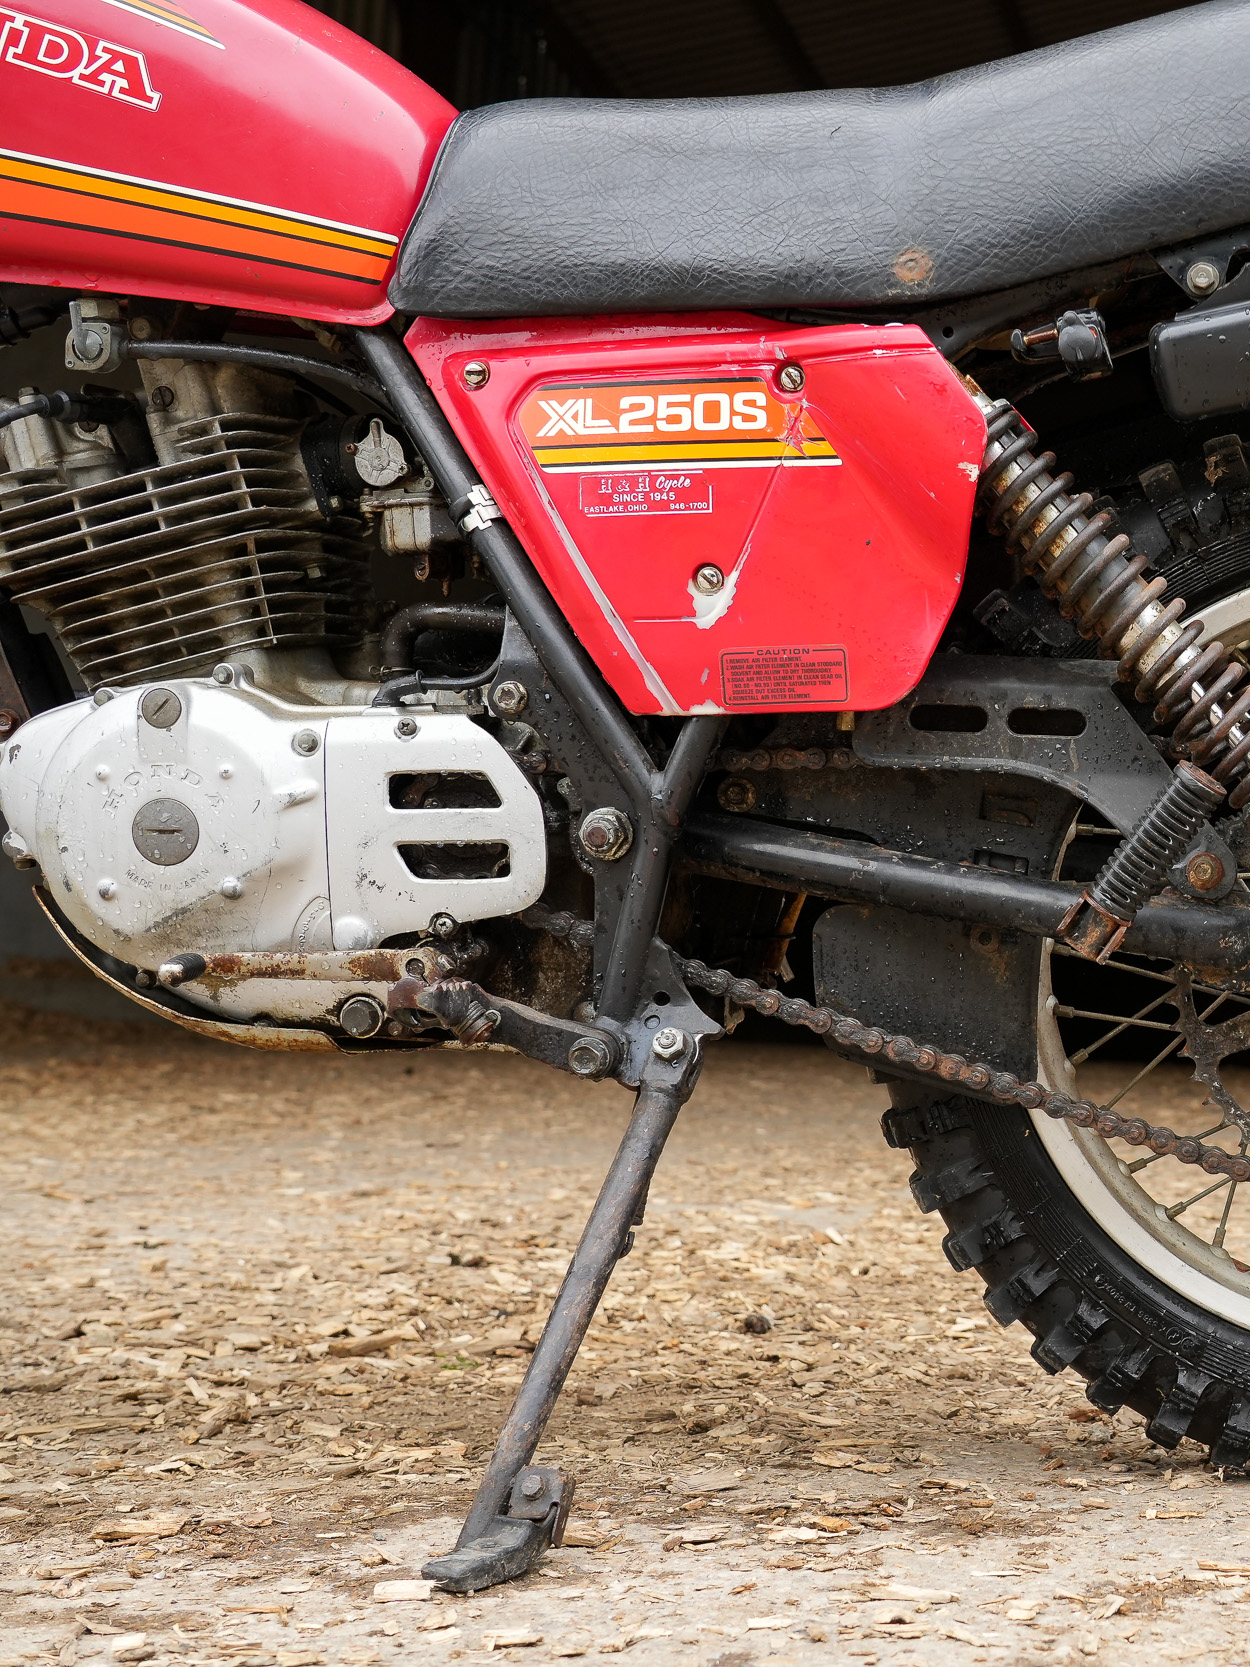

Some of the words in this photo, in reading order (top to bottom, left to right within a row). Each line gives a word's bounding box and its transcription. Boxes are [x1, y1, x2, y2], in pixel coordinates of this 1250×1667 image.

[536, 391, 768, 437] XL250S
[655, 475, 691, 492] Cycle
[612, 493, 645, 502] SINCE
[649, 491, 676, 501] 1945
[670, 502, 708, 510] 946-1700
[757, 648, 810, 656] CAUTION
[102, 762, 224, 816] HONDA
[125, 869, 154, 889] MADE
[176, 869, 210, 890] JAPAN
